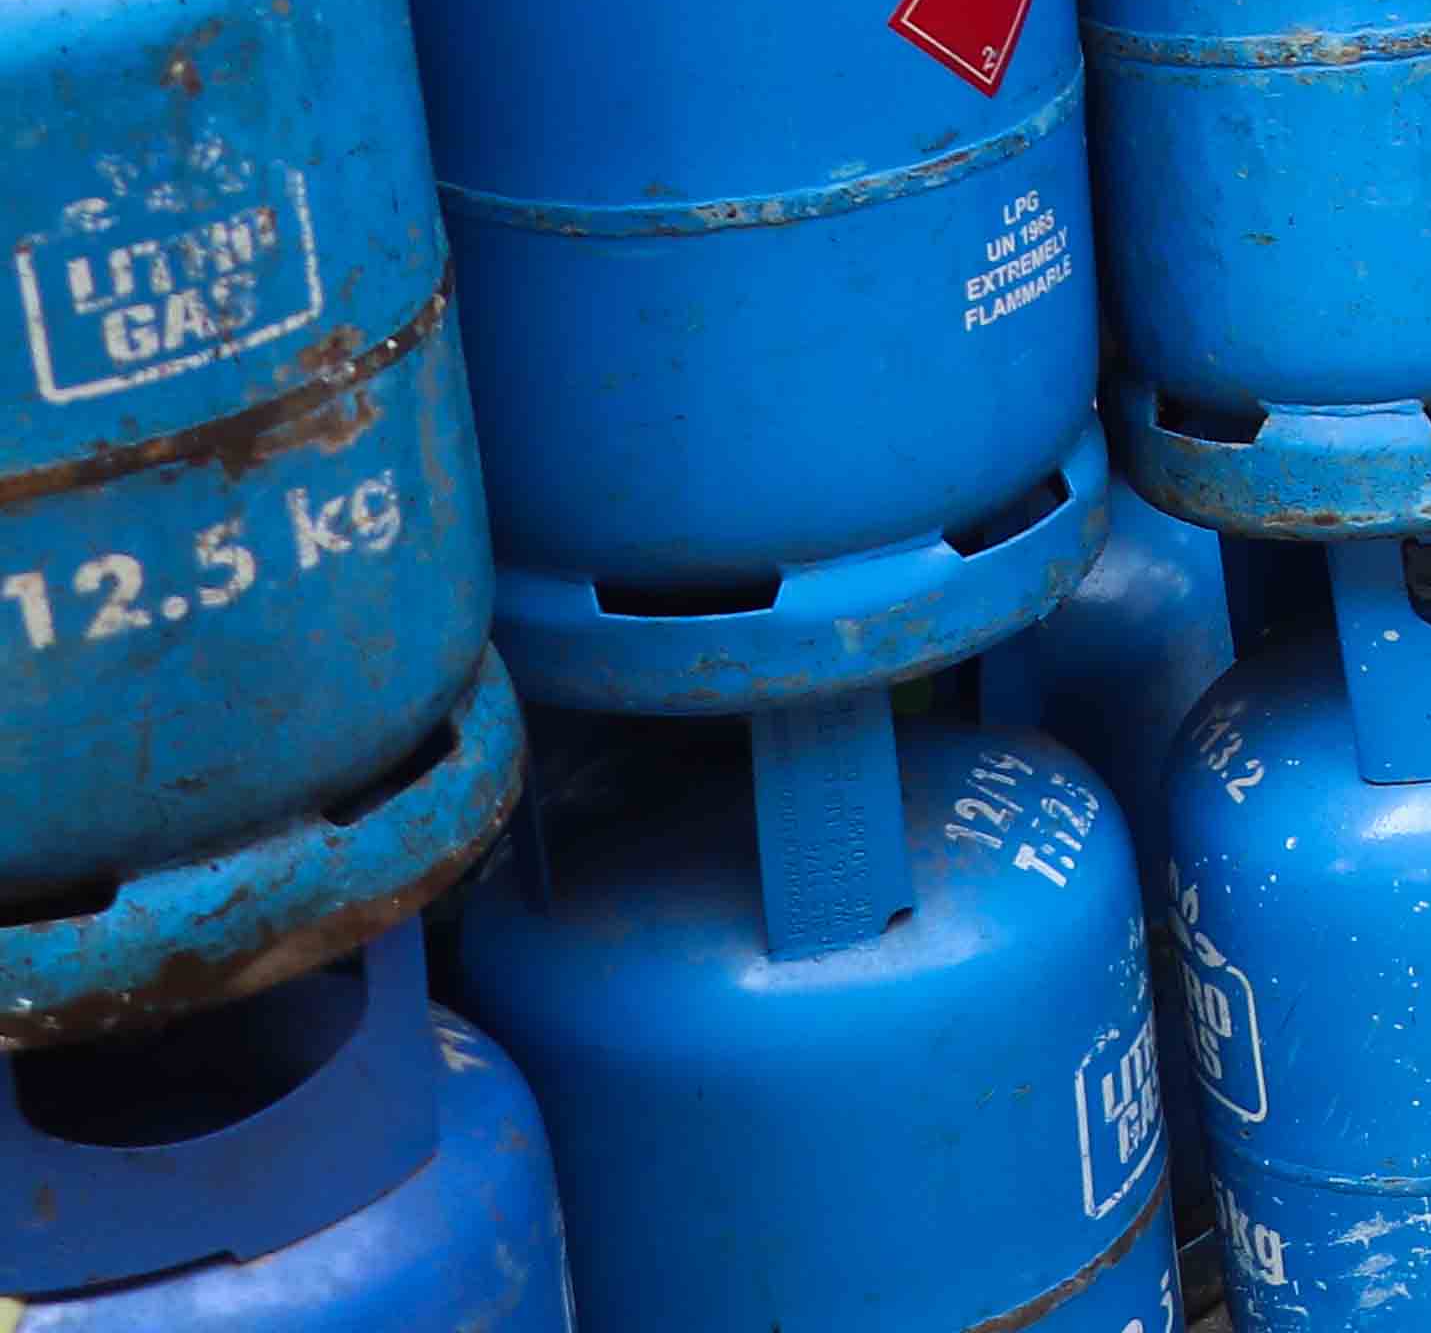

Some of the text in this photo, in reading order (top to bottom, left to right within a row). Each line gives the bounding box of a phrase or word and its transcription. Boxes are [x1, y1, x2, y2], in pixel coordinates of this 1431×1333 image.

[986, 208, 1055, 262] UN 1965
[1003, 190, 1040, 227] LPG
[964, 253, 1073, 332] FLAMMABLE
[965, 226, 1070, 302] EXTREMELY
[102, 272, 257, 363] GAS
[1, 469, 401, 650] 12.5 kg
